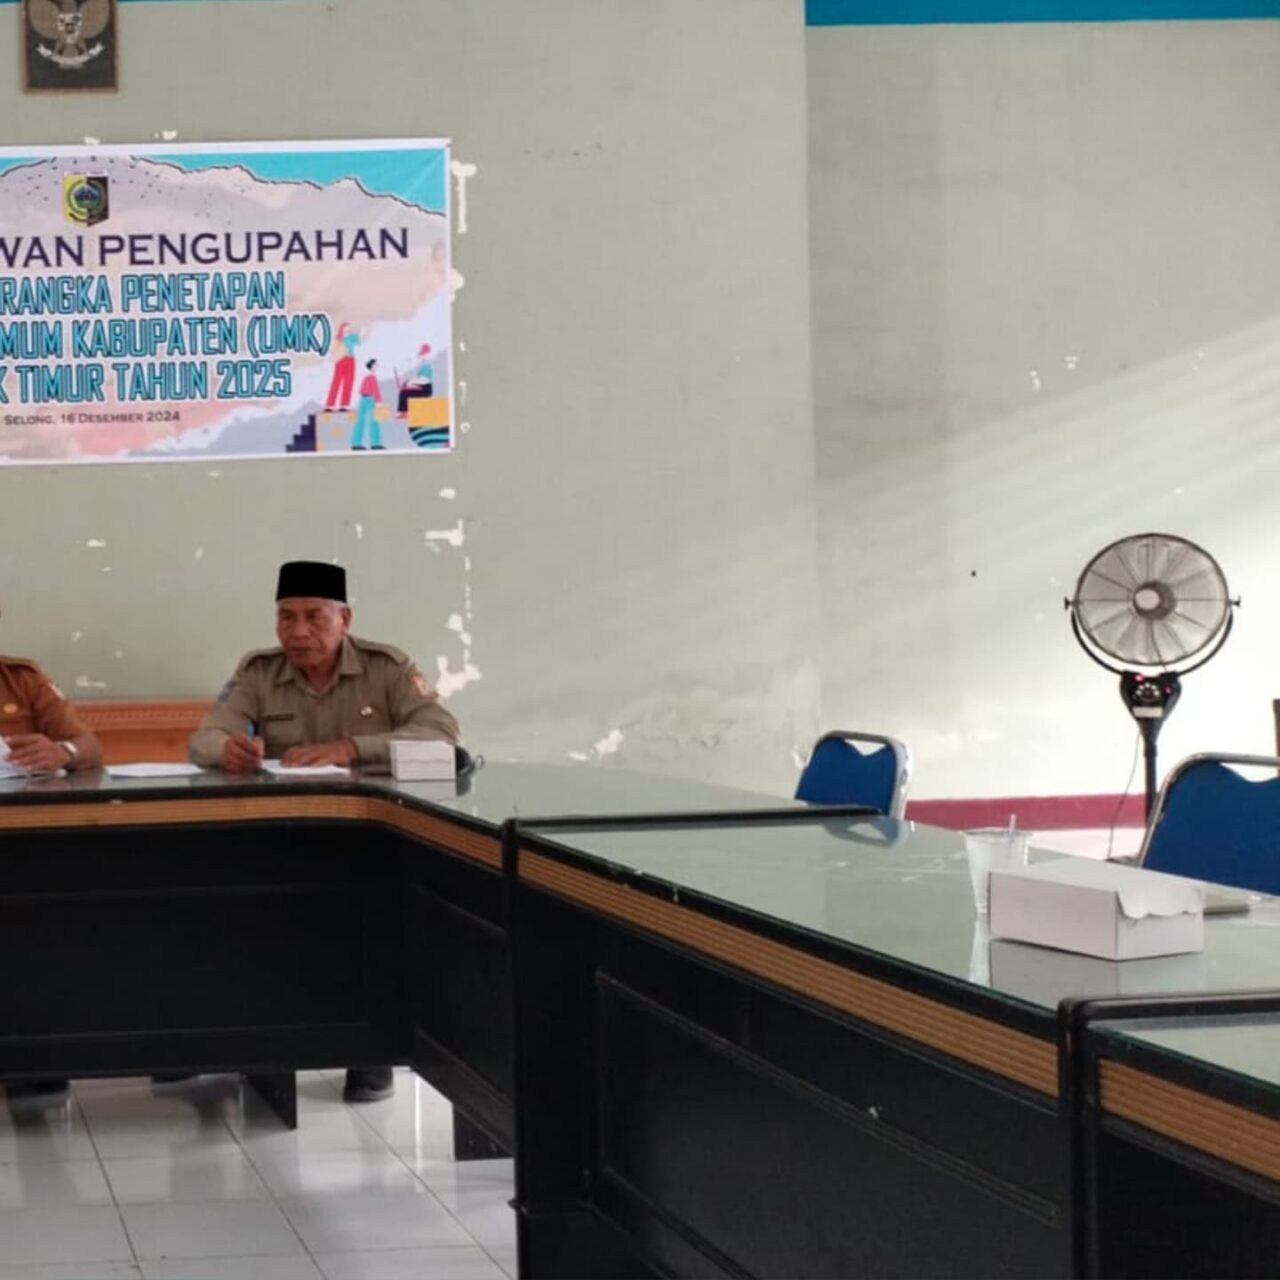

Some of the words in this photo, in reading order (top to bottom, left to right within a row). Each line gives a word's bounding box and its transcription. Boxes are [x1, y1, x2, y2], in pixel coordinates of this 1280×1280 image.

[99, 228, 409, 266] PENGUPAHAN
[120, 271, 286, 313] PENETAPAN
[72, 316, 238, 358] KABUPATEN
[246, 313, 332, 358] (UMK)
[14, 363, 105, 404] TIMUR
[112, 361, 208, 402] TAHUN
[216, 359, 292, 400] 2025
[61, 413, 76, 424] 16
[146, 410, 181, 422] 2024
